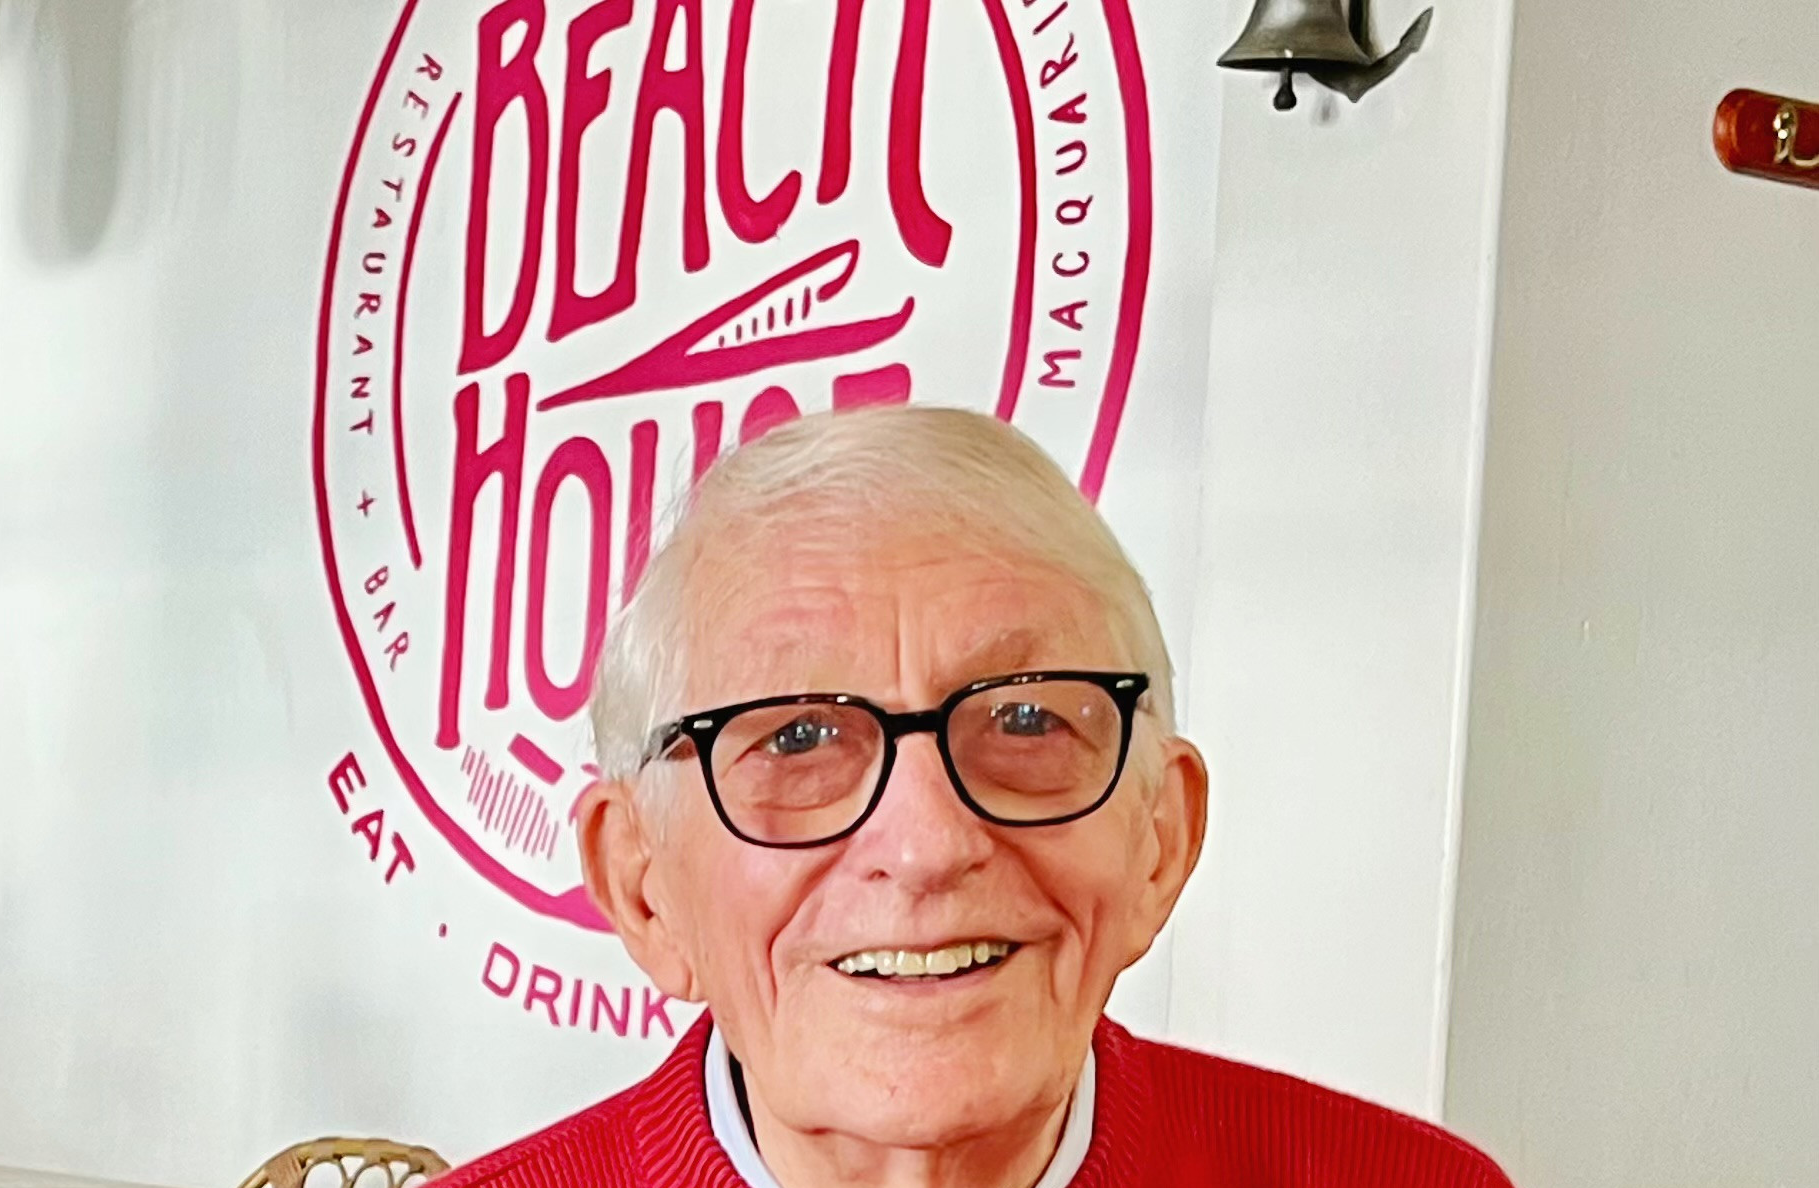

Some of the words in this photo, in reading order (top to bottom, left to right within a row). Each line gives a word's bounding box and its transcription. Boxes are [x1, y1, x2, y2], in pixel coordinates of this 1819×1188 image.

[349, 53, 444, 436] RESTAURANT
[1023, 0, 1094, 388] MACQUARI
[364, 565, 411, 672] BAR
[328, 751, 416, 885] EAT
[482, 941, 675, 1039] DRINK
